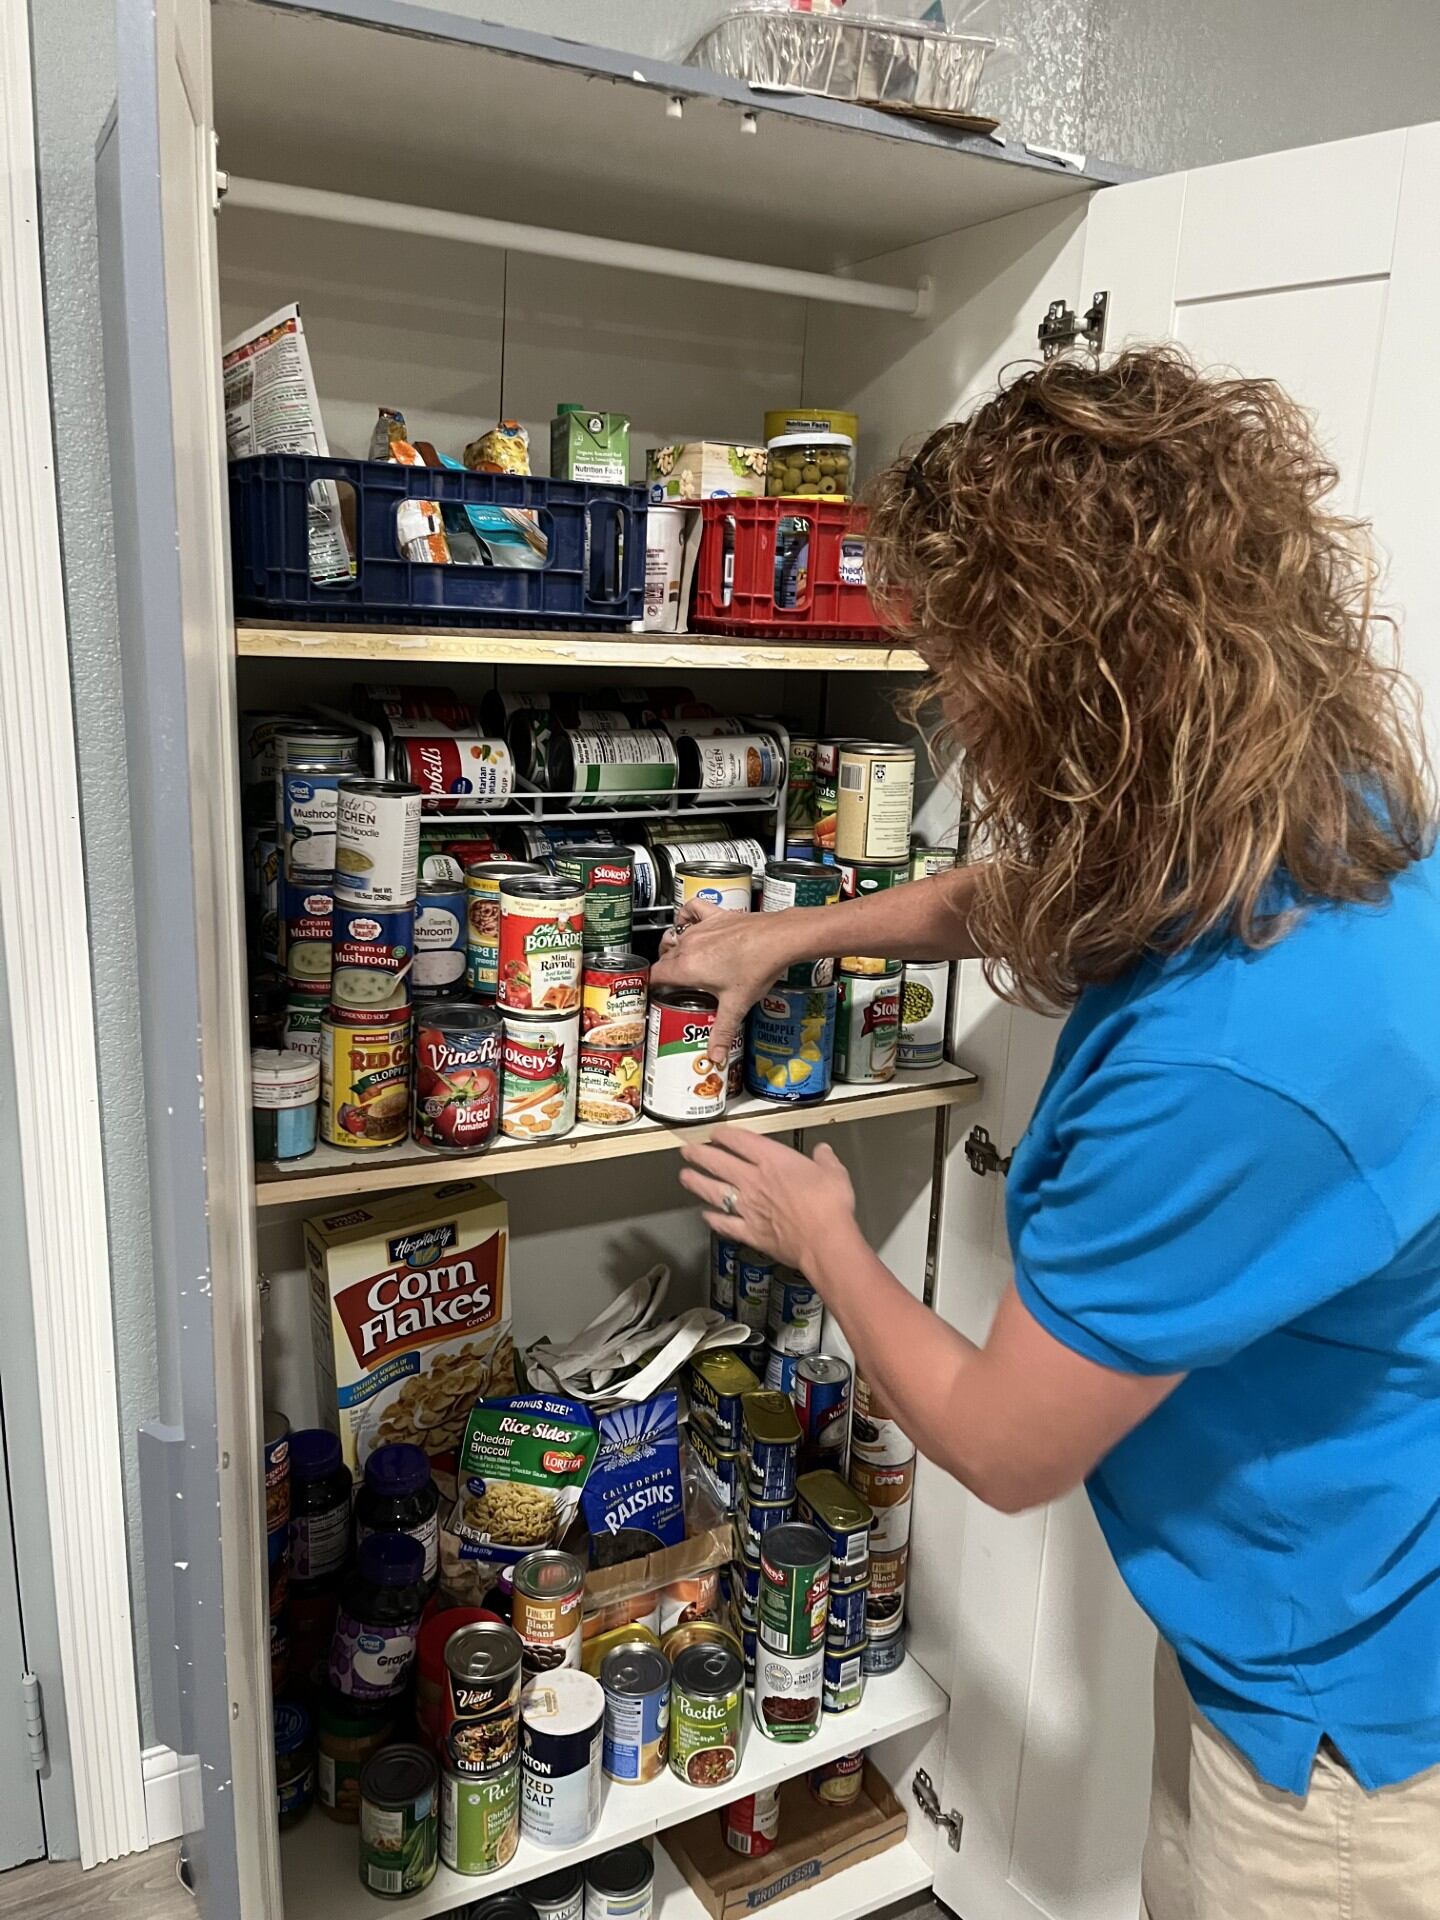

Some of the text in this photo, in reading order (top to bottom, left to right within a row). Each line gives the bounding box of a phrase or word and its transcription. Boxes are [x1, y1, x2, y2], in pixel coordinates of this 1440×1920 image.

[575, 464, 604, 474] Nutrition
[715, 748, 726, 789] ITCHEN
[293, 807, 337, 819] Mushroo
[350, 826, 380, 838] Noodle
[593, 864, 632, 881] Stokely's
[299, 918, 331, 927] Cream
[290, 927, 334, 938] Mushro
[414, 926, 454, 937] shroom
[343, 943, 387, 954] Cream of
[551, 953, 568, 961] Mini
[335, 952, 400, 968] Mushroom
[540, 958, 576, 972] Ravioli
[614, 978, 643, 989] PASTA
[617, 988, 641, 997] SELECT
[763, 996, 787, 1014] Dole
[373, 1012, 391, 1021] SOUP
[757, 1031, 790, 1046] CHUNKS
[347, 1049, 391, 1073] RED
[427, 1043, 480, 1073] Vine
[504, 1046, 559, 1072] okely's
[580, 1056, 612, 1069] PASTA
[583, 1066, 607, 1075] SELECT
[455, 1103, 491, 1124] Diced
[457, 1121, 489, 1132] tomatoes
[395, 1222, 453, 1258] Hospitality
[366, 1259, 478, 1312] Corn
[359, 1283, 492, 1357] Flakes
[466, 1311, 493, 1329] Cereal
[693, 1376, 720, 1412] SPAM
[509, 1399, 544, 1410] BONUS
[472, 1430, 516, 1447] Cheddar
[498, 1416, 573, 1444] Rice Sides
[470, 1442, 511, 1458] Broccoli
[600, 1428, 660, 1456] SUN VALLEY
[690, 1431, 719, 1473] SPAM
[602, 1468, 673, 1501] CALIFORNIA
[604, 1484, 676, 1536] RAISINS
[525, 1626, 555, 1638] Beans
[527, 1618, 555, 1630] Black
[376, 1650, 413, 1667] Grape
[677, 1695, 727, 1721] Pacific
[457, 1760, 485, 1772] Chili
[522, 1750, 552, 1775] RTON
[523, 1773, 554, 1795] IZED
[525, 1788, 555, 1808] SALT
[753, 1862, 816, 1906] PROGRESSO
